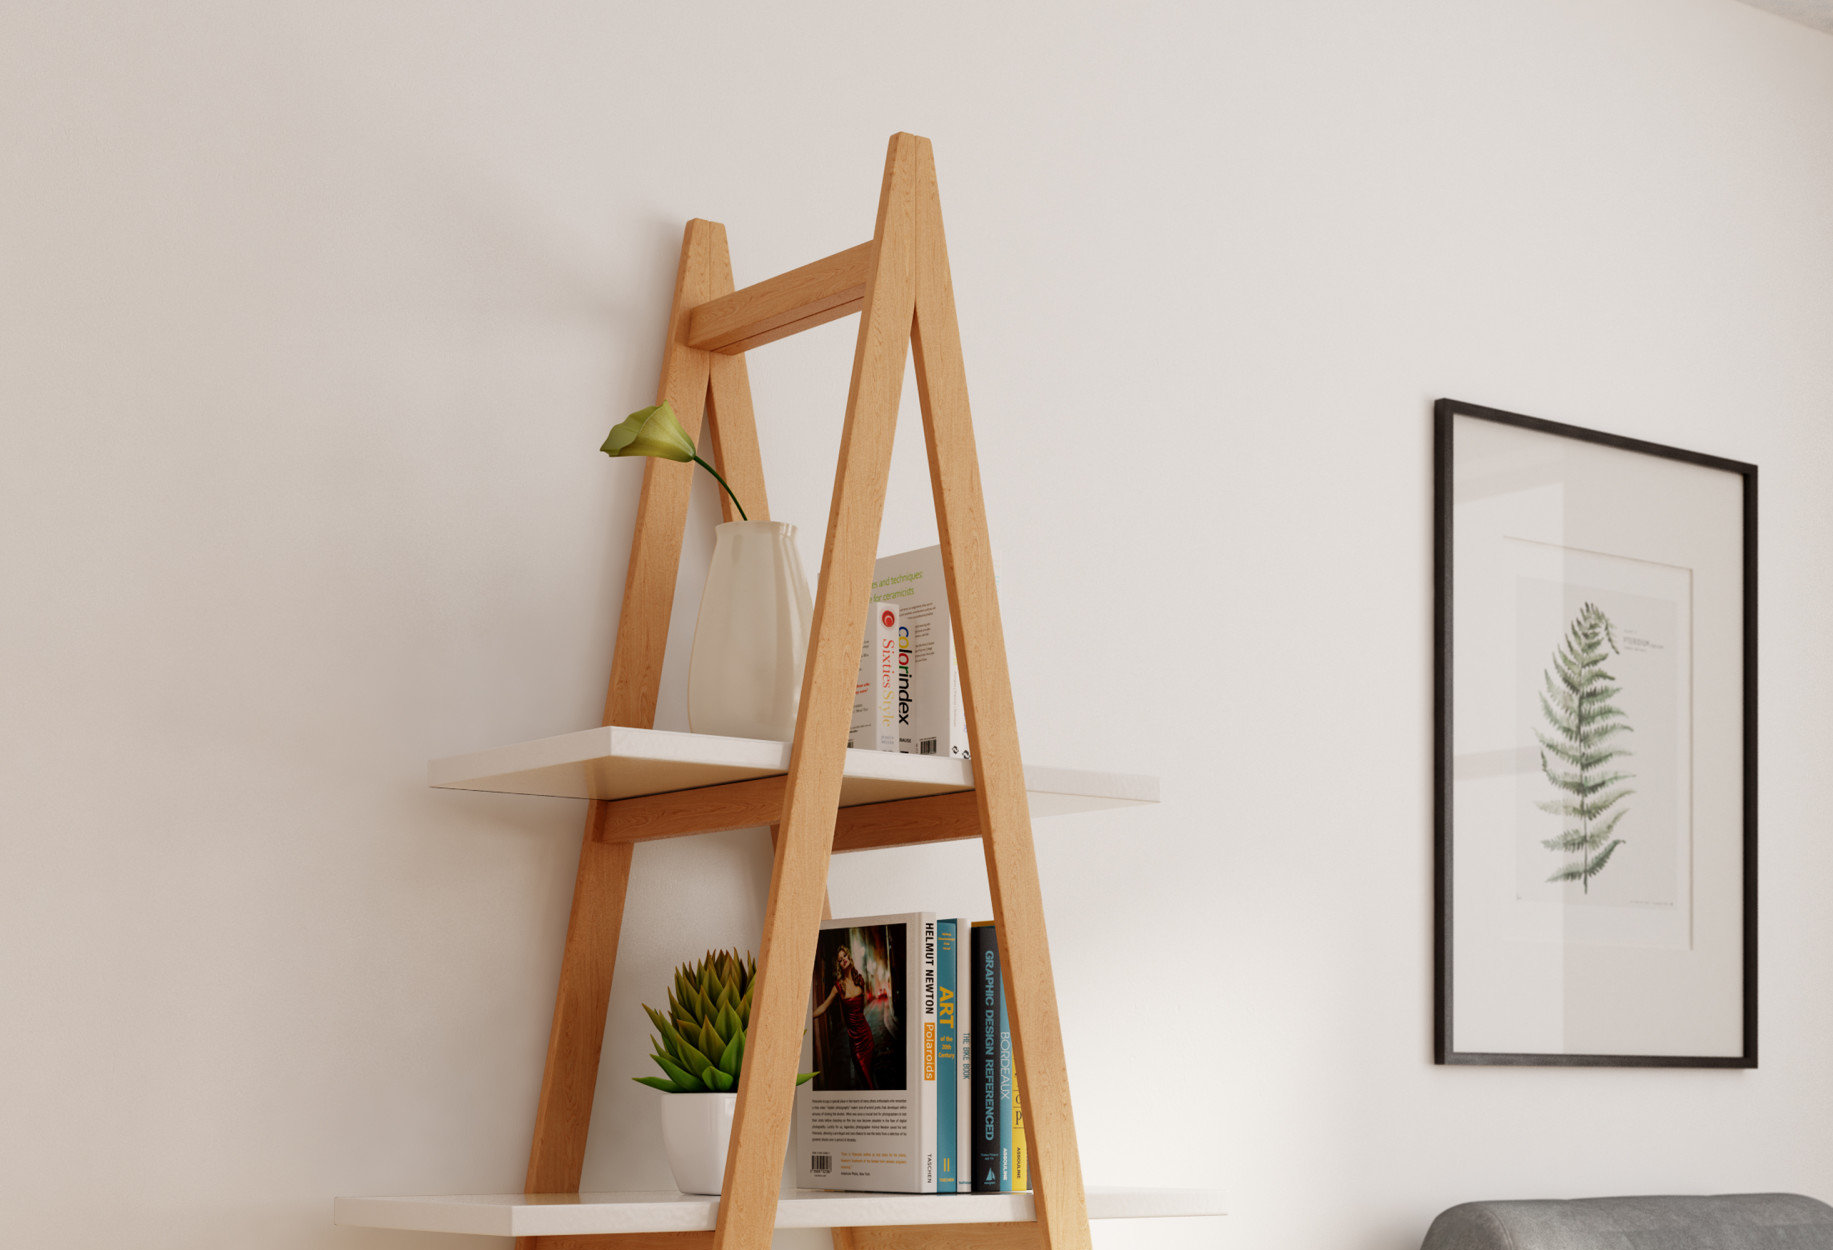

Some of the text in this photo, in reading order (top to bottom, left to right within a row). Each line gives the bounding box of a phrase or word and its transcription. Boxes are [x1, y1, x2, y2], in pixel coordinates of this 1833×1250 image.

[882, 638, 895, 688] Sixties
[879, 689, 895, 728] Style
[925, 922, 934, 1080] HELMUT NEWTON Polaroids
[939, 986, 954, 1029] ART
[963, 1033, 971, 1080] THE BIKE BOOK
[985, 950, 994, 1141] GRAPHIC DESIGN REFERENCED
[1000, 1032, 1011, 1101] BORDEAUX
